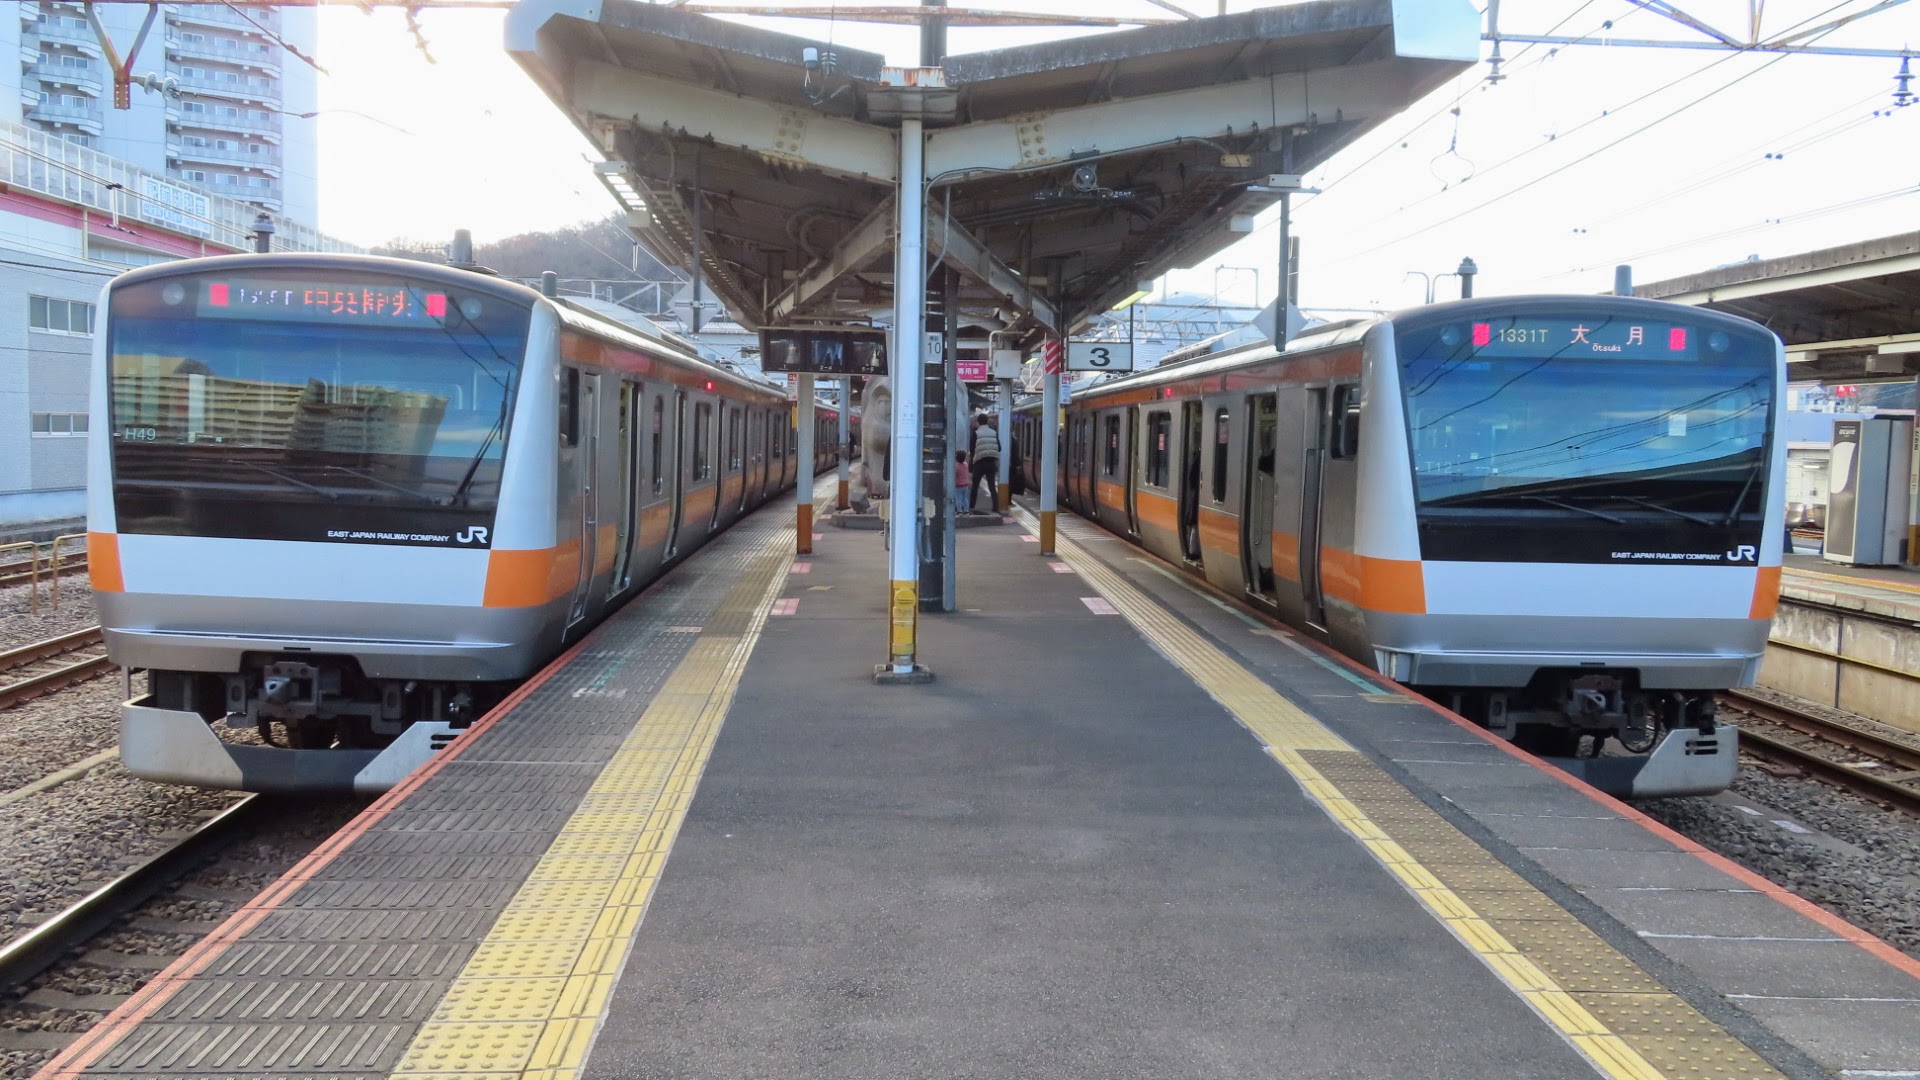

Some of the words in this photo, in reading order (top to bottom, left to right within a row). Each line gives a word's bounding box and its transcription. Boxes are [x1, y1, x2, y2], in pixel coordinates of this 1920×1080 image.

[1499, 329, 1549, 343] 1331T
[927, 342, 941, 354] 10
[1089, 347, 1111, 367] 3
[125, 427, 156, 441] H49
[1425, 461, 1452, 474] T12
[327, 530, 350, 538] EAST
[410, 534, 450, 542] COMPANY
[456, 525, 488, 544] JR
[1656, 552, 1685, 560] RAILWAY
[1726, 545, 1756, 561] JR
